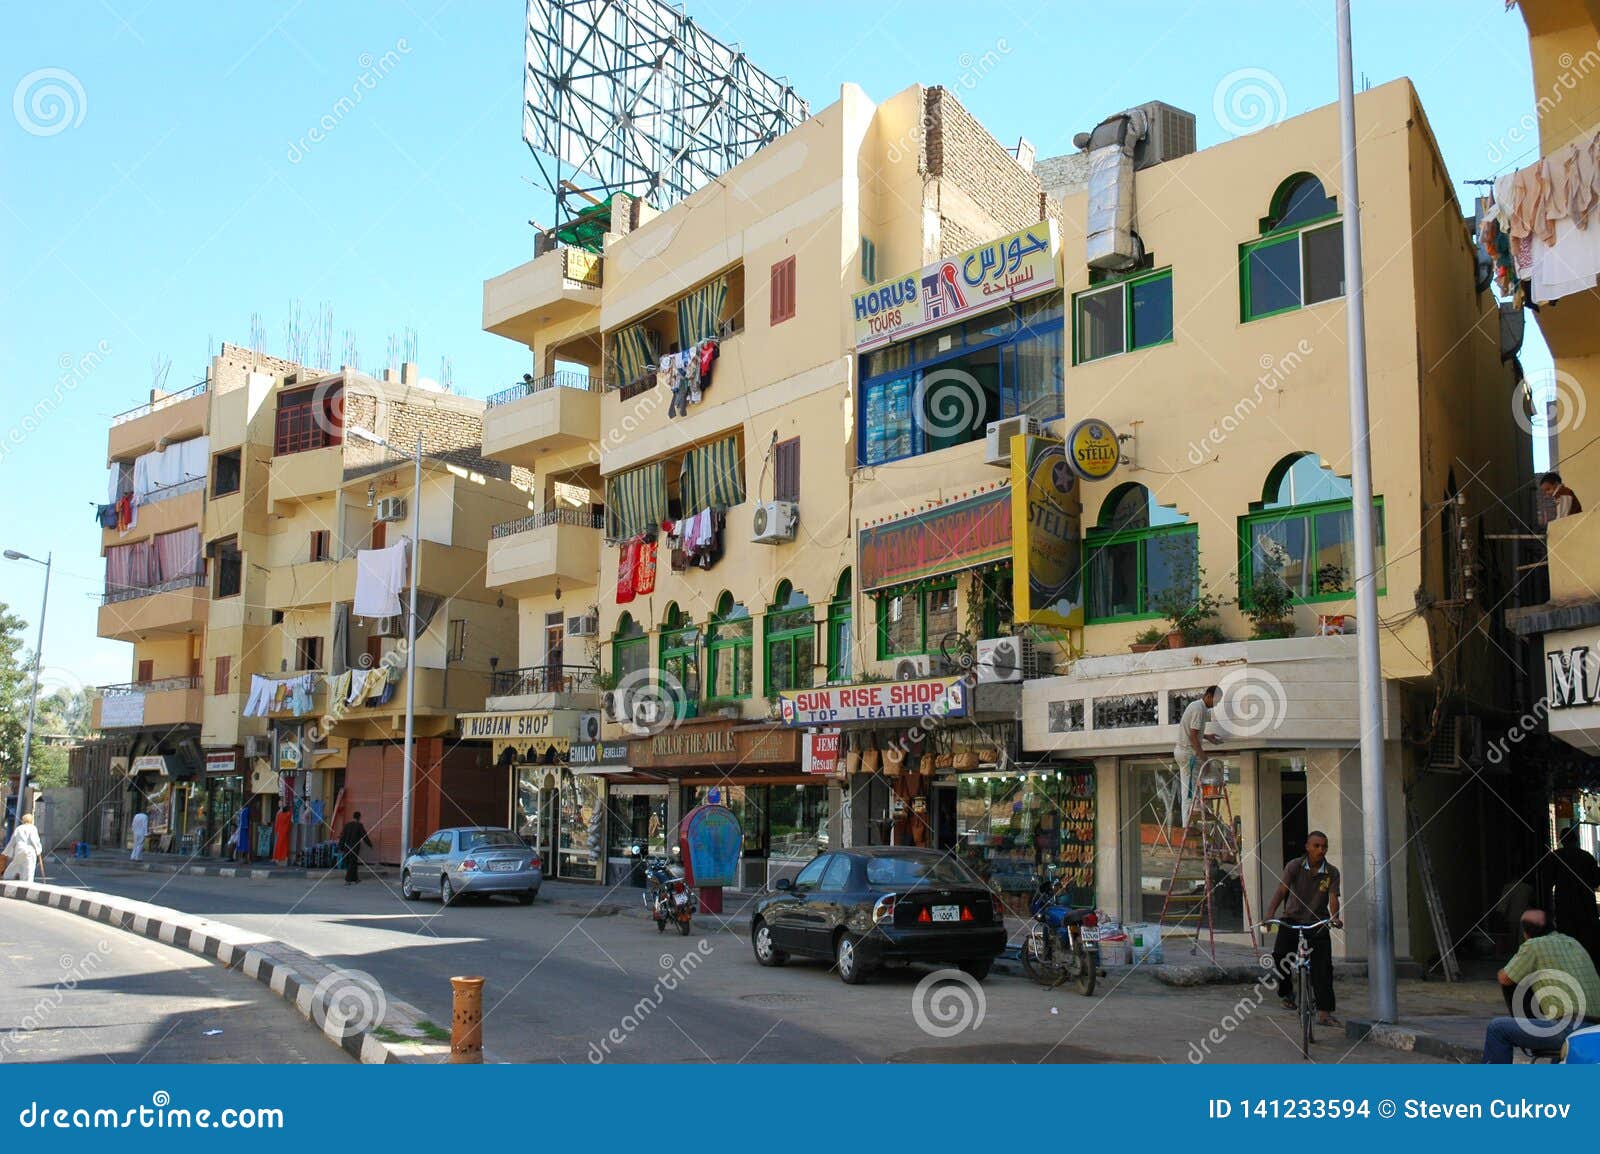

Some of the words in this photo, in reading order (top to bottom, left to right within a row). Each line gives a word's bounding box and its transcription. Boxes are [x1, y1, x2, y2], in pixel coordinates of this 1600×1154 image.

[963, 232, 1048, 288] حورس
[982, 264, 1034, 297] للسياحة
[854, 278, 917, 321] HORUS
[868, 309, 902, 335] TOURS
[1077, 446, 1116, 462] STELLA
[1547, 646, 1600, 709] M
[797, 691, 831, 712] SUN
[839, 687, 883, 708] RISE
[890, 682, 944, 704] SHOP
[471, 716, 512, 736] NUBIAN
[518, 714, 549, 735] SHOP
[808, 709, 838, 722] TOP
[856, 703, 931, 720] LEATHER
[569, 744, 596, 762] EMILIO
[704, 731, 737, 753] NILE
